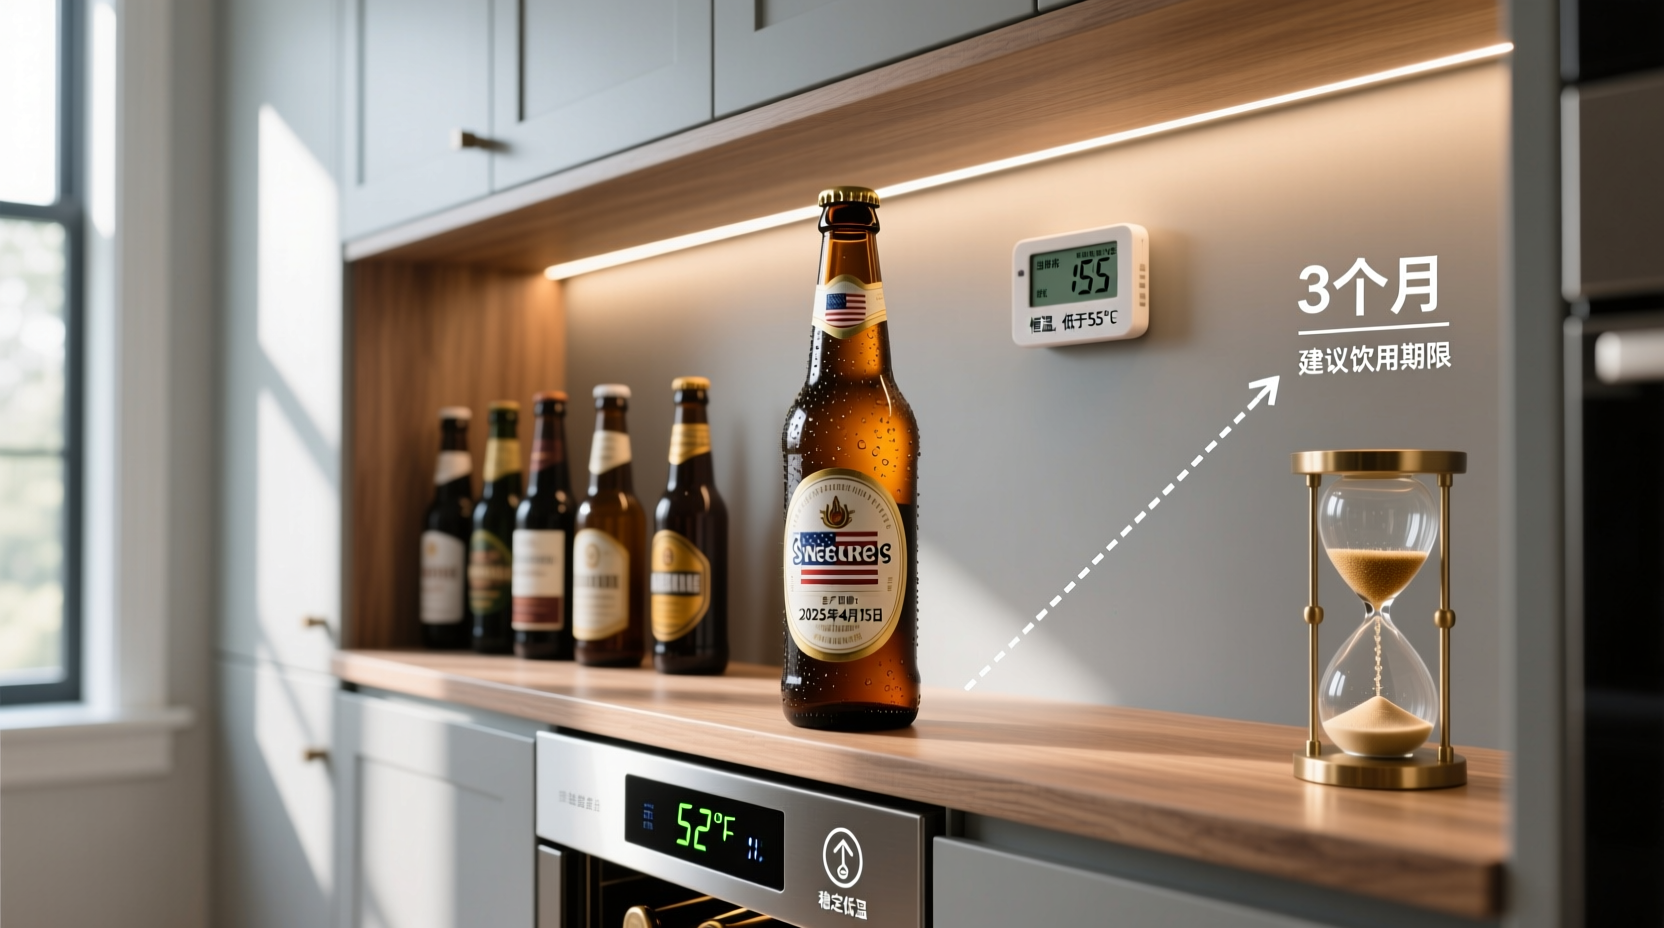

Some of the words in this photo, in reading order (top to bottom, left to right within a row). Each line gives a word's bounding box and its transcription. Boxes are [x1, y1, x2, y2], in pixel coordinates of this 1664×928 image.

[798, 608, 883, 623] 2025年4月15日
[676, 802, 736, 852] 52°F
